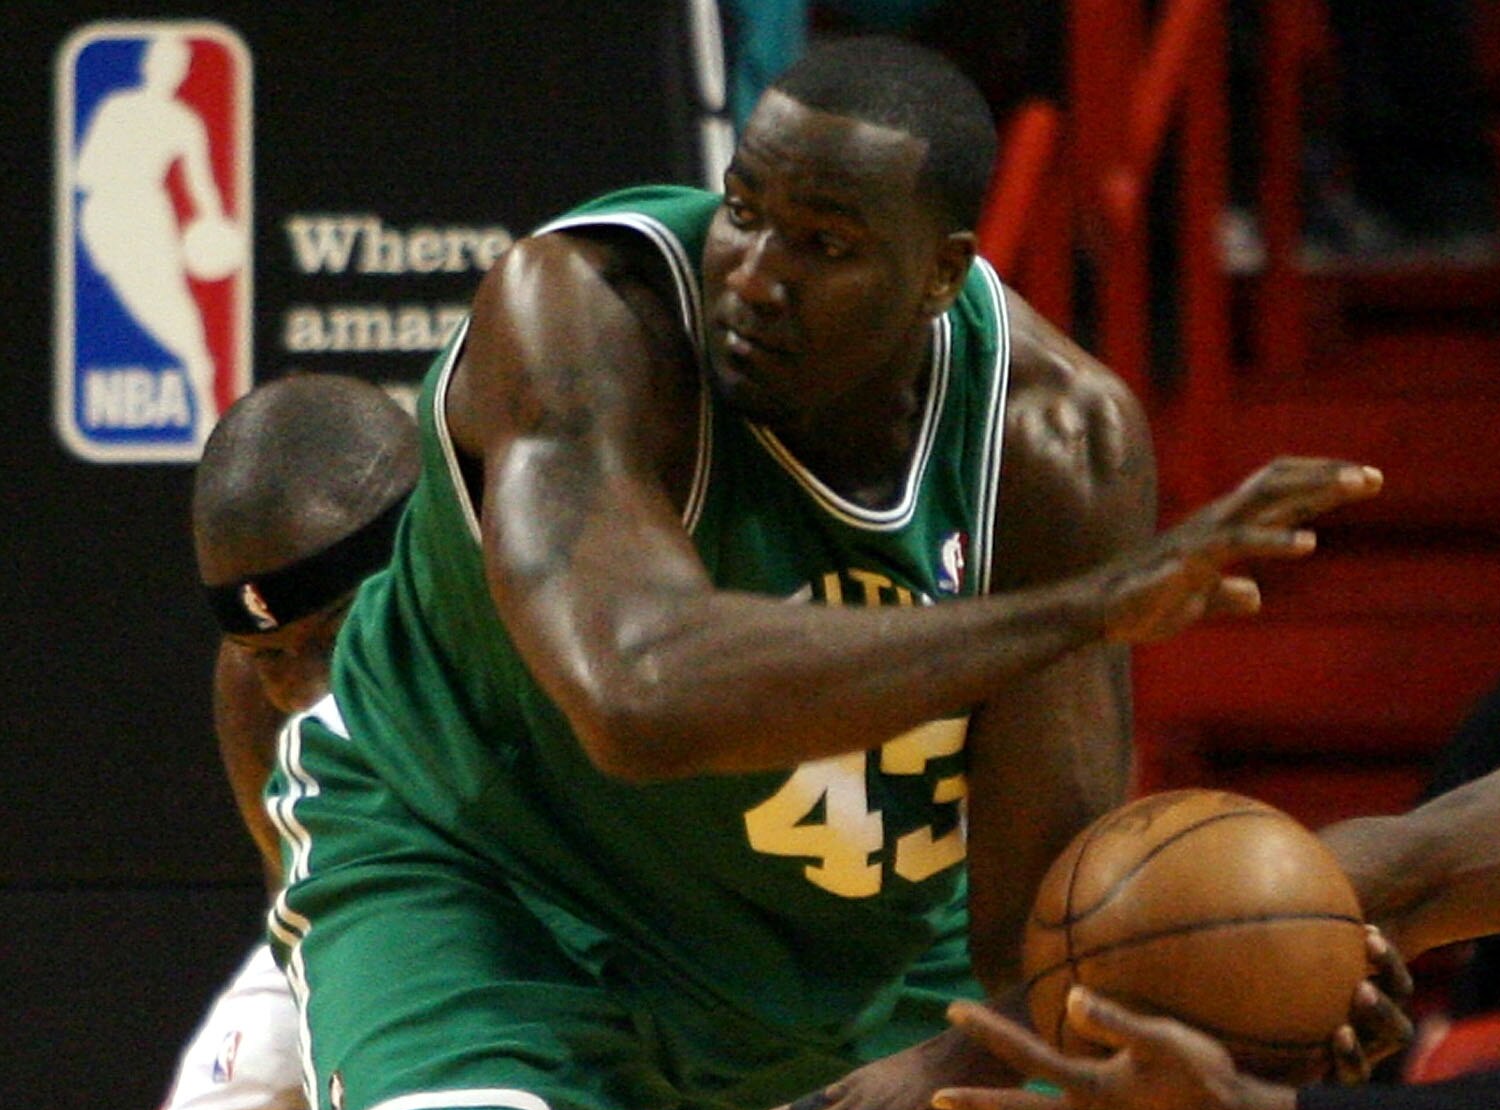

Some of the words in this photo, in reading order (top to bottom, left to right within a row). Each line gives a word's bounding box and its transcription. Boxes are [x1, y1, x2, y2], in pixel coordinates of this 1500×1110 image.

[285, 214, 514, 275] Where
[85, 367, 190, 428] NBA
[744, 718, 969, 898] 43
